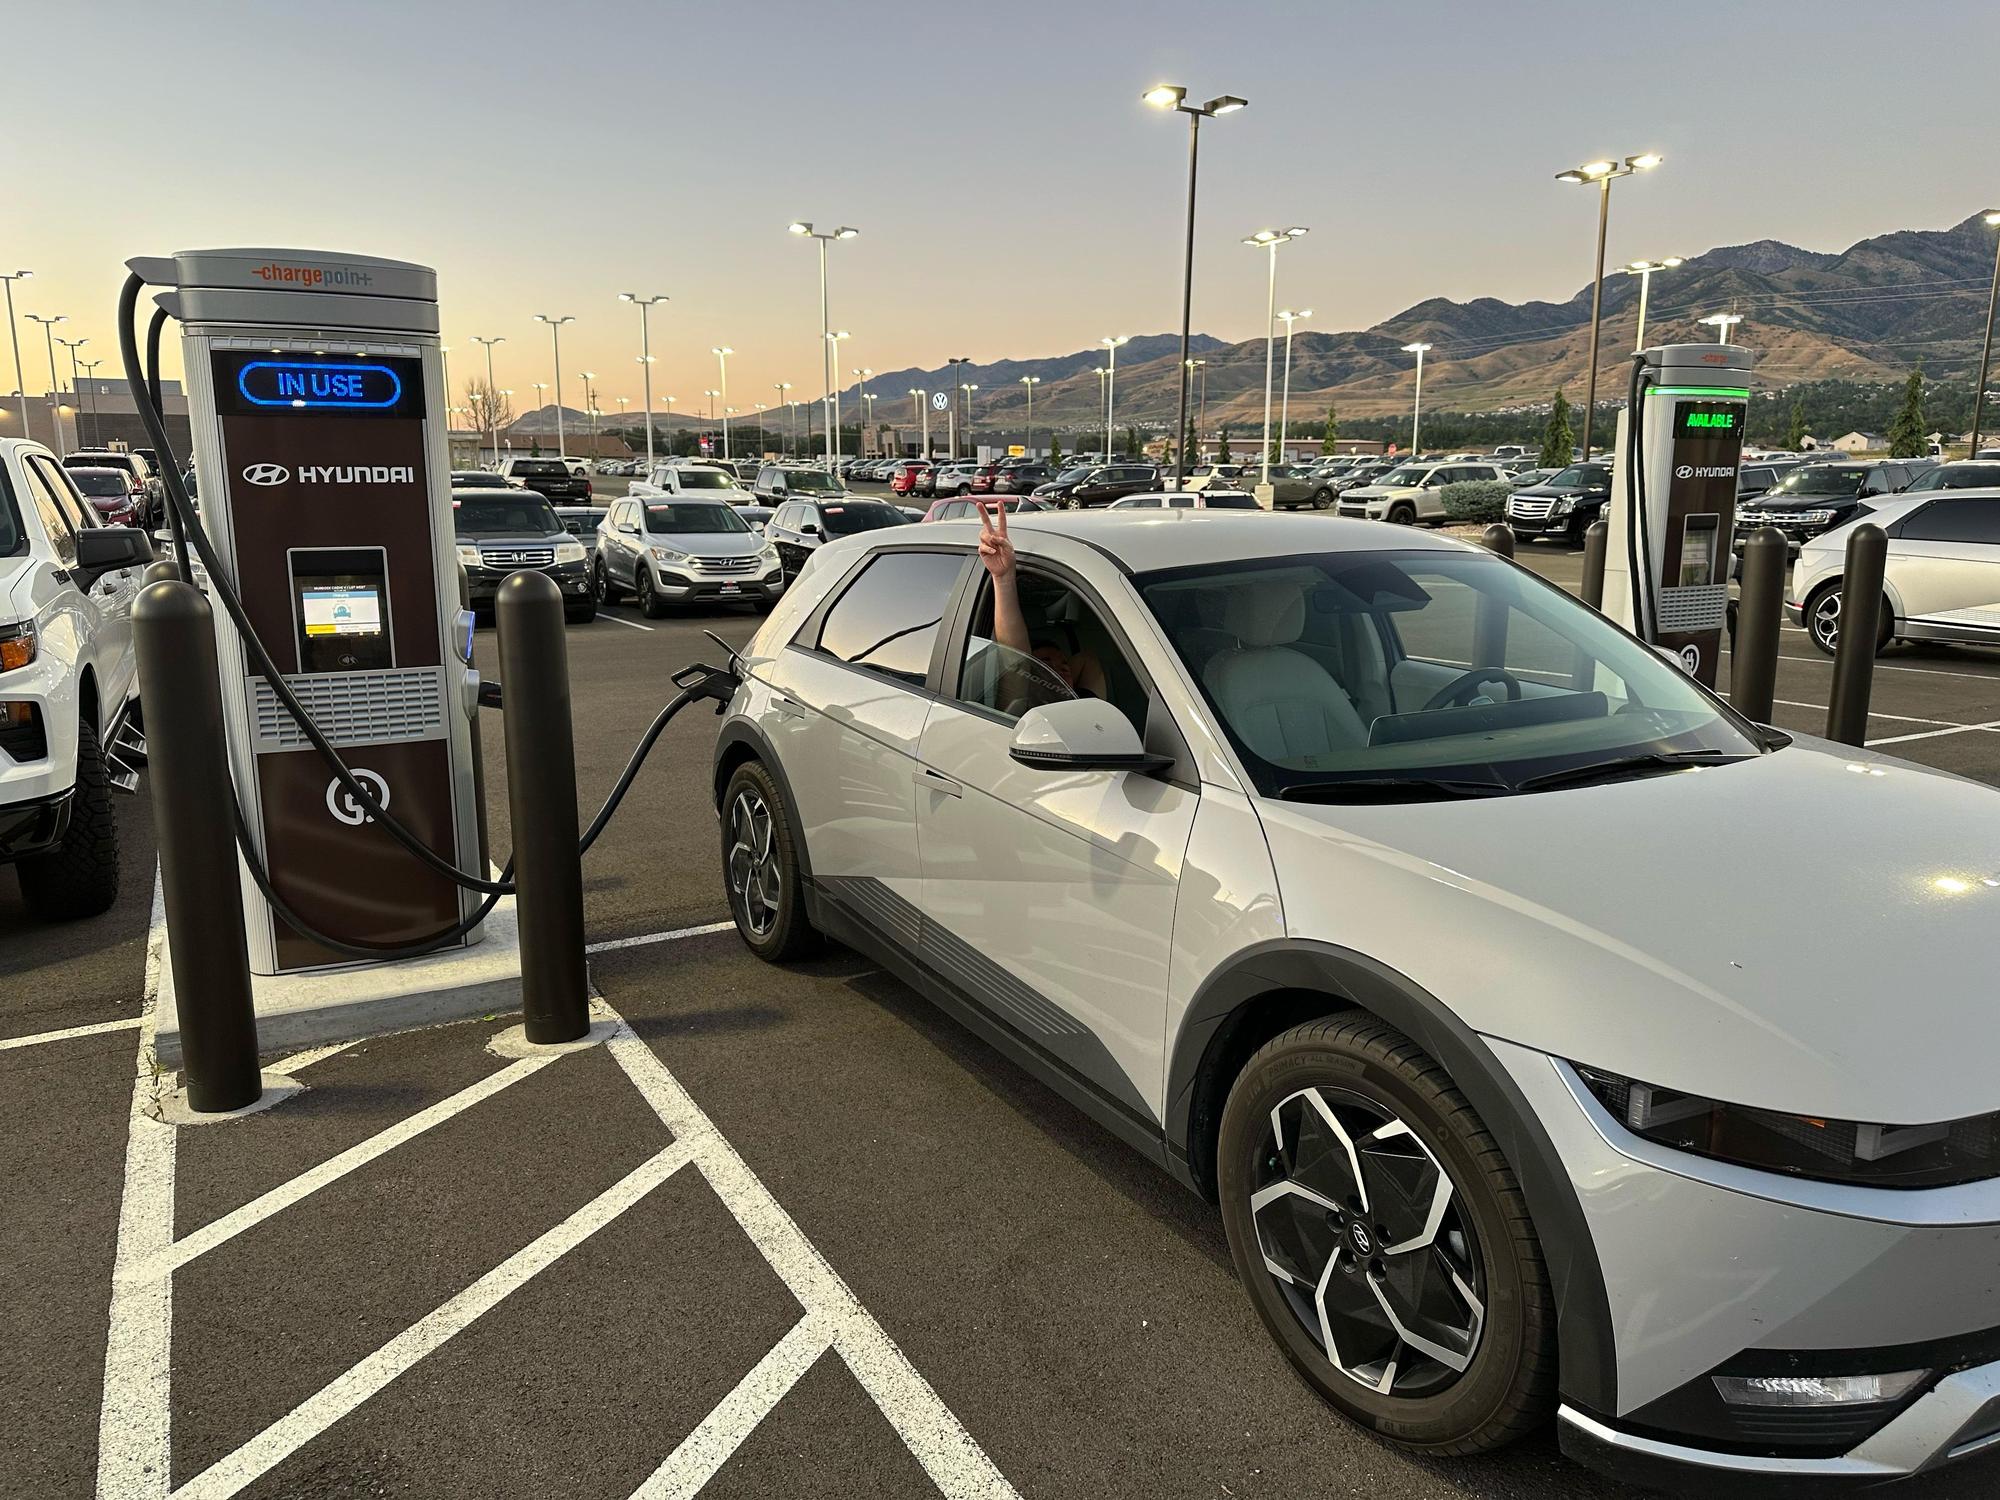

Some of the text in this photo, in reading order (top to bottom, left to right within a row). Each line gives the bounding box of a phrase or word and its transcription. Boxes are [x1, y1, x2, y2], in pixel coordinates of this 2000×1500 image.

[278, 372, 364, 398] IN USE
[1687, 413, 1733, 428] AVAILABLE
[298, 466, 415, 483] HYUNDAI
[1695, 466, 1735, 478] HYUNDAI
[1269, 1055, 1306, 1076] PRIMACY
